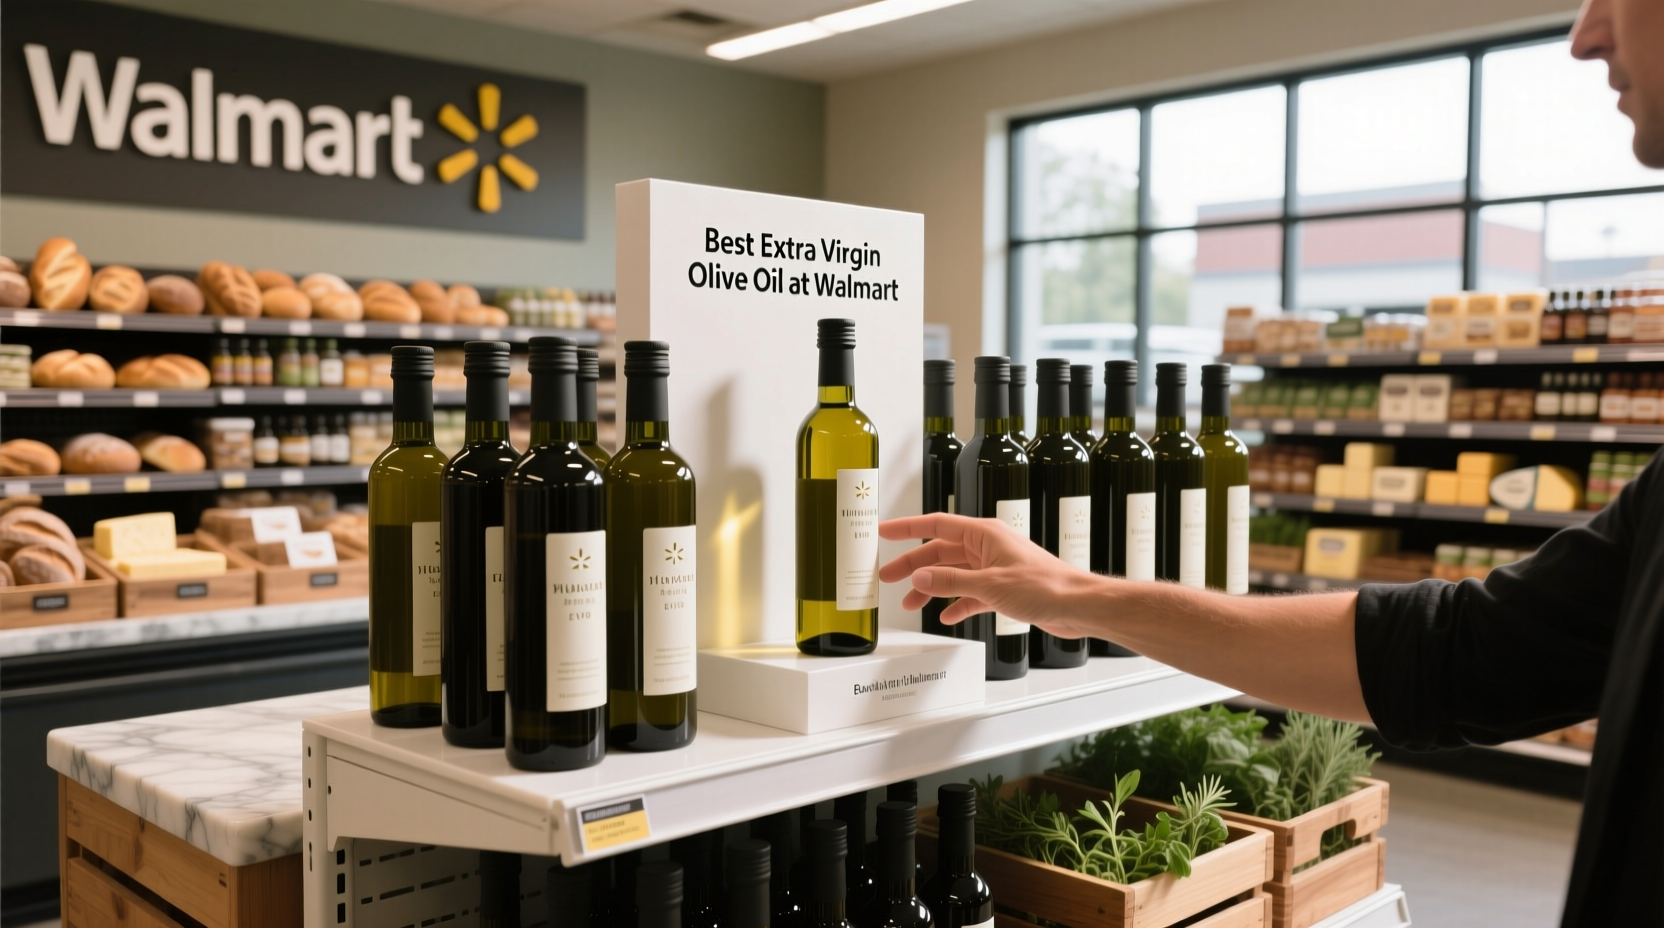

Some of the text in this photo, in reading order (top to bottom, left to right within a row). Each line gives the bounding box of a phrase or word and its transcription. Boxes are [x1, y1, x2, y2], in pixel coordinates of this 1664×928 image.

[24, 44, 425, 185] Walmart
[705, 227, 881, 272] Best Extra Virgin
[688, 261, 899, 301] Olive Oil at Walmart
